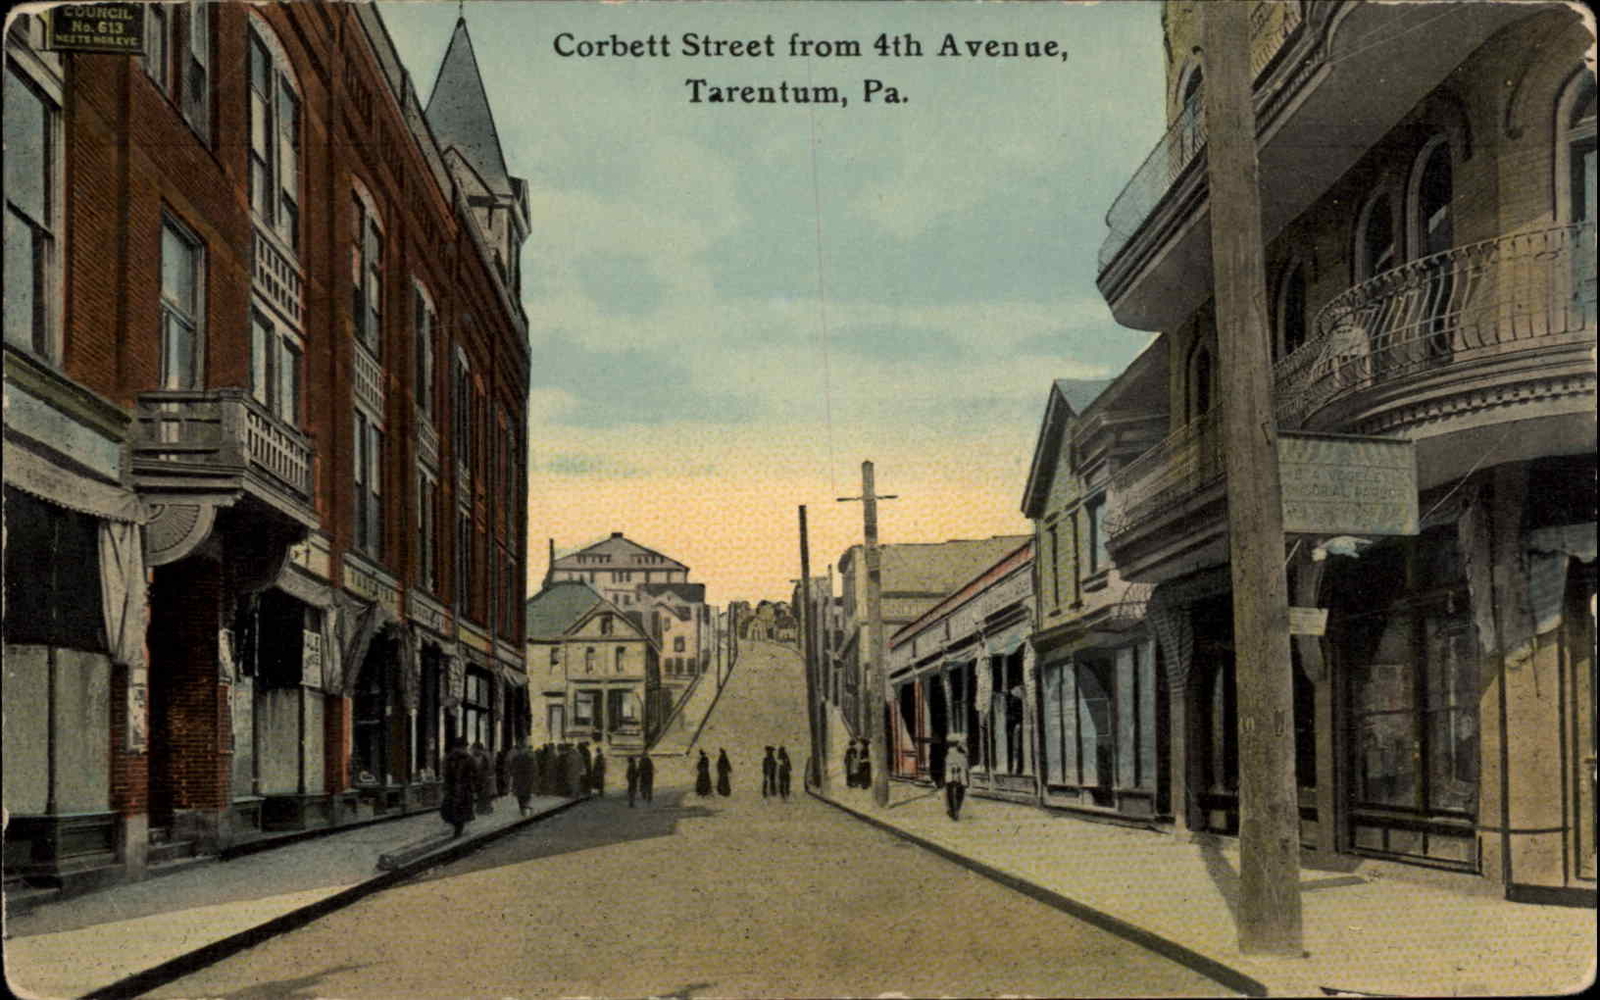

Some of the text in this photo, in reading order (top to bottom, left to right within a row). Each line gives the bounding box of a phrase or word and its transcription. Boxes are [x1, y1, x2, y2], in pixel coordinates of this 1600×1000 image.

[63, 5, 134, 20] COUNCIL
[71, 20, 125, 34] No. 613
